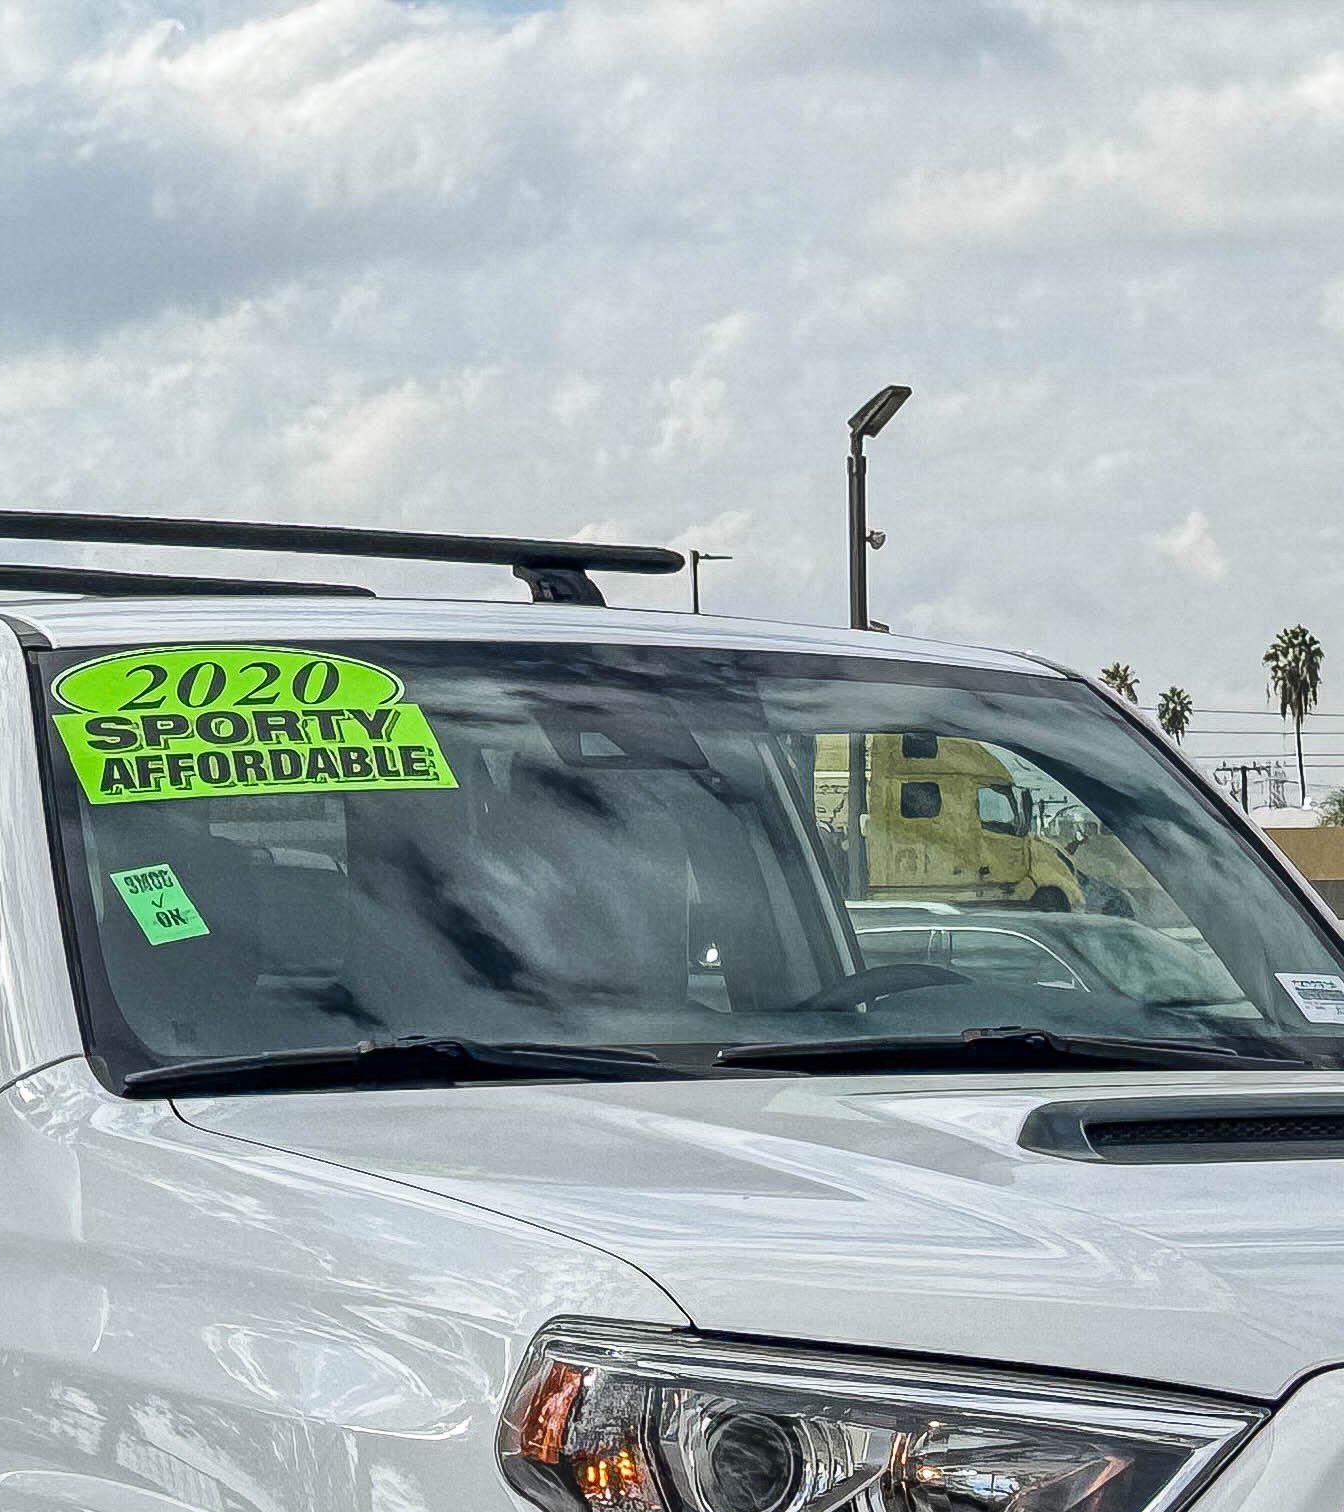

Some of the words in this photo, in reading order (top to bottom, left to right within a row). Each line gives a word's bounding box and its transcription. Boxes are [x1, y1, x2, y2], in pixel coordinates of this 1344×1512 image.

[119, 660, 340, 711] 2020
[85, 709, 399, 751] SPORTY
[99, 746, 436, 795] AFFORDABLE
[156, 908, 187, 928] OK
